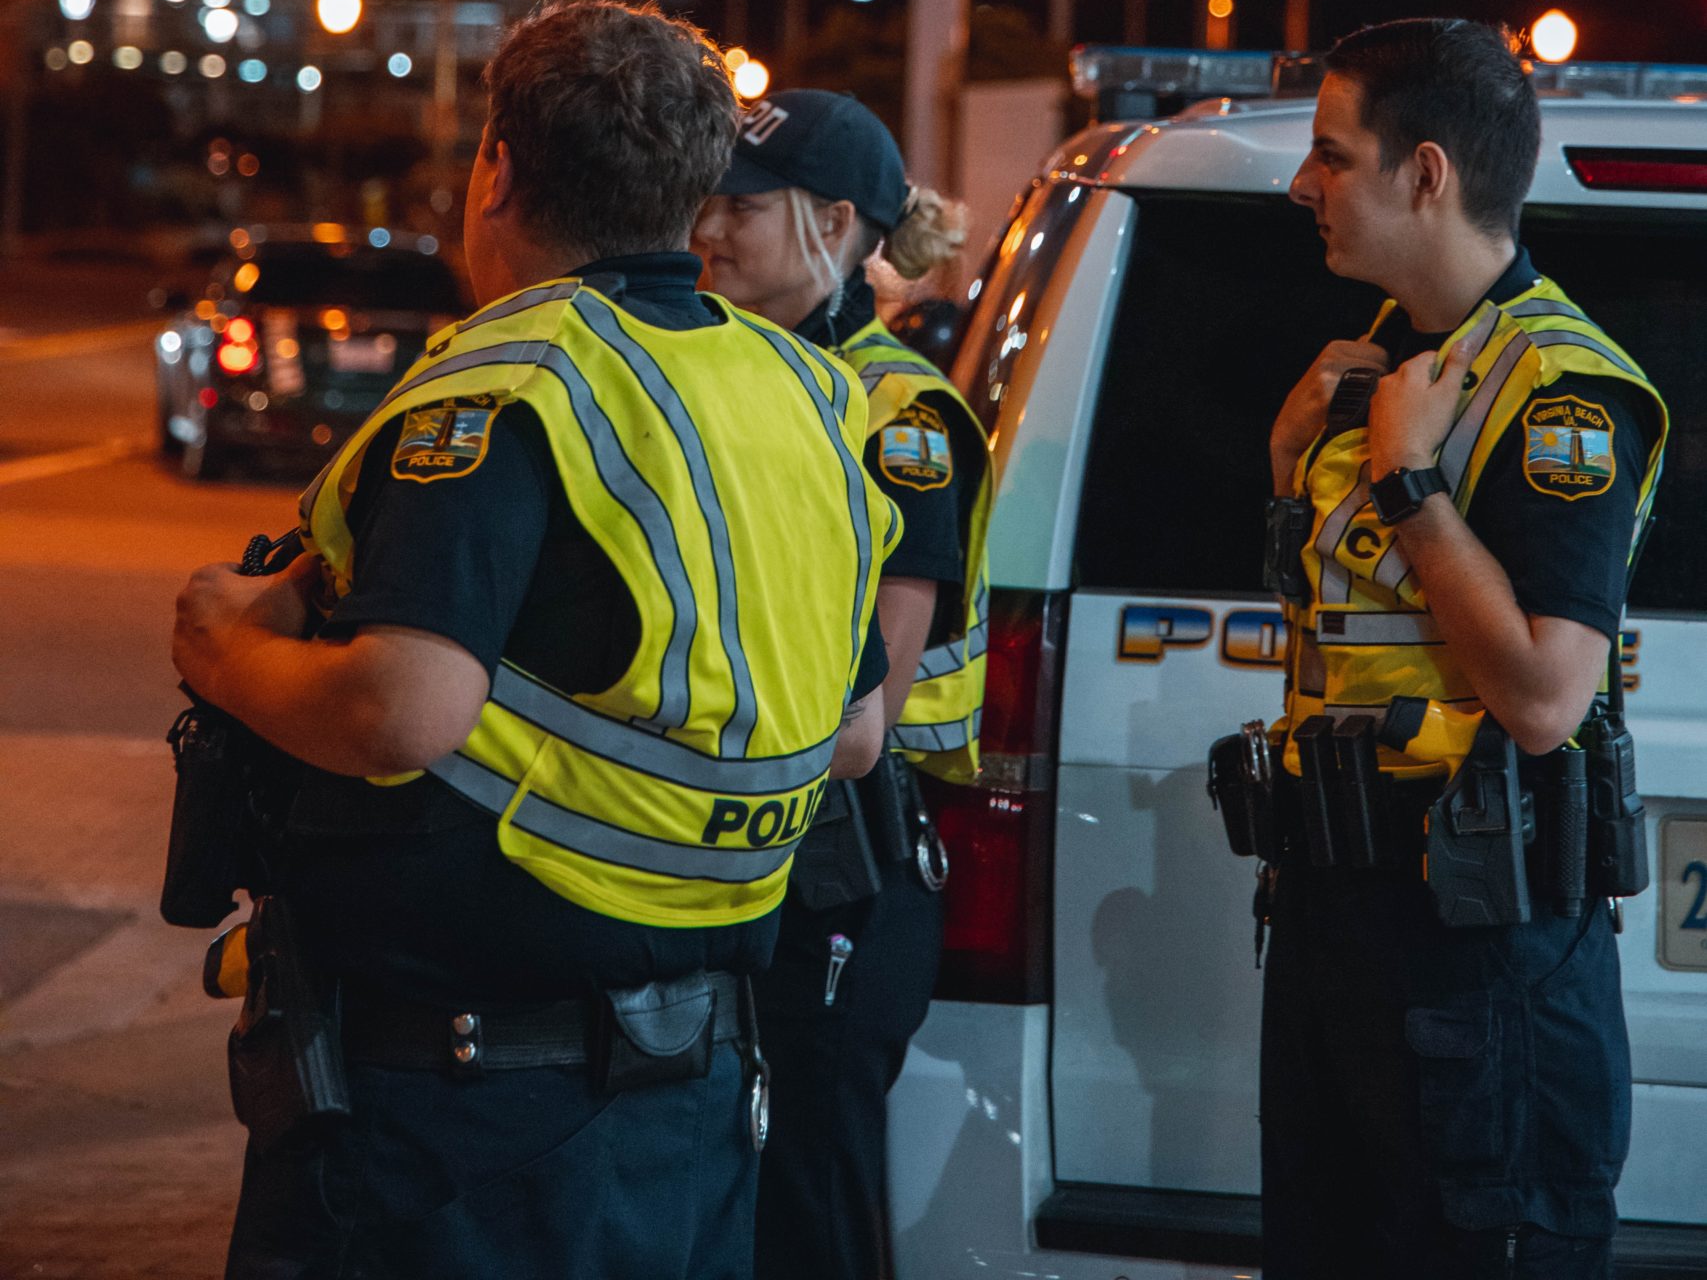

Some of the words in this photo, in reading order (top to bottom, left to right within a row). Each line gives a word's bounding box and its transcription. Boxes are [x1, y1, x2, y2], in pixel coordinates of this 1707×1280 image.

[1532, 405, 1571, 423] VIRGINIA
[1575, 406, 1604, 428] BEACH
[408, 455, 455, 468] POLICE
[1549, 473, 1594, 485] POLICE
